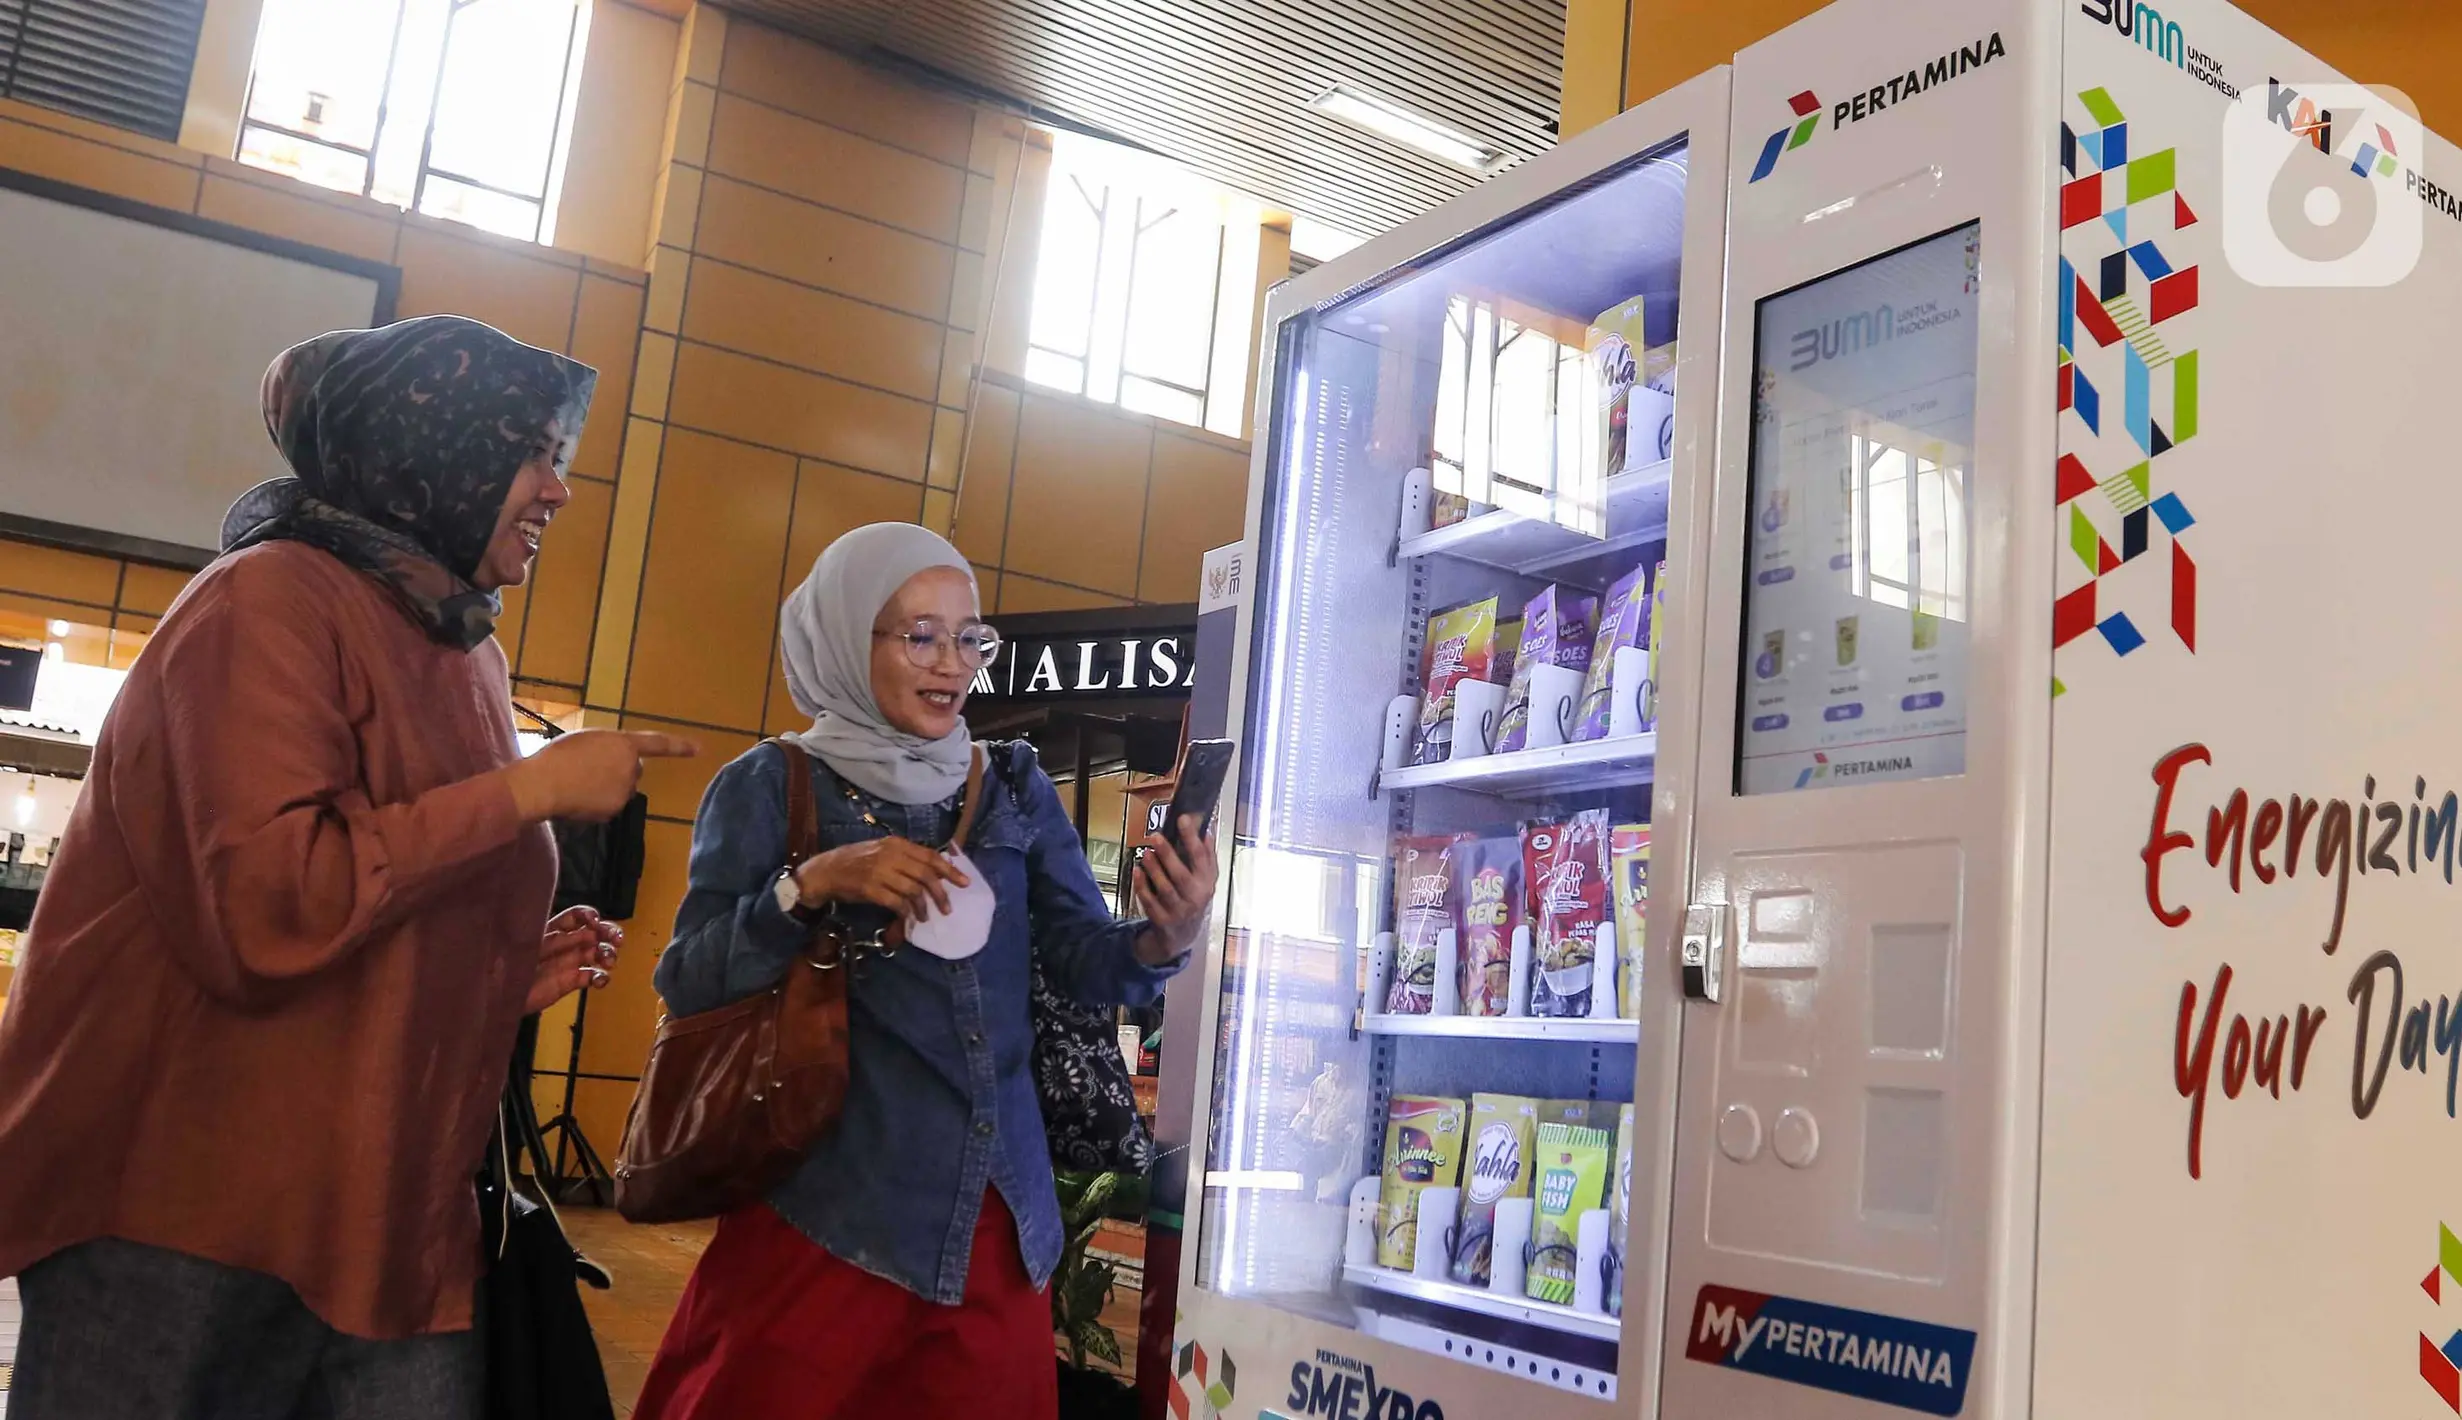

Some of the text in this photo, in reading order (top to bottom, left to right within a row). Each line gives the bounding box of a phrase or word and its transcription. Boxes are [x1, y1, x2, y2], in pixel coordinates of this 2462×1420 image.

[2187, 45, 2224, 77] UNTUK
[1833, 31, 2006, 131] PERTAMINA
[2186, 61, 2243, 104] INDONESIA
[2267, 76, 2332, 156] KAI
[1896, 308, 1962, 338] INDONESIA
[1024, 637, 1196, 692] ALIS
[1834, 756, 1913, 779] PERTAMINA
[2141, 742, 2462, 956] Energizin
[1471, 875, 1505, 903] BAS
[2174, 962, 2328, 1180] Your
[1544, 1173, 1577, 1192] BABY
[1316, 1347, 1363, 1375] PERTAMINA
